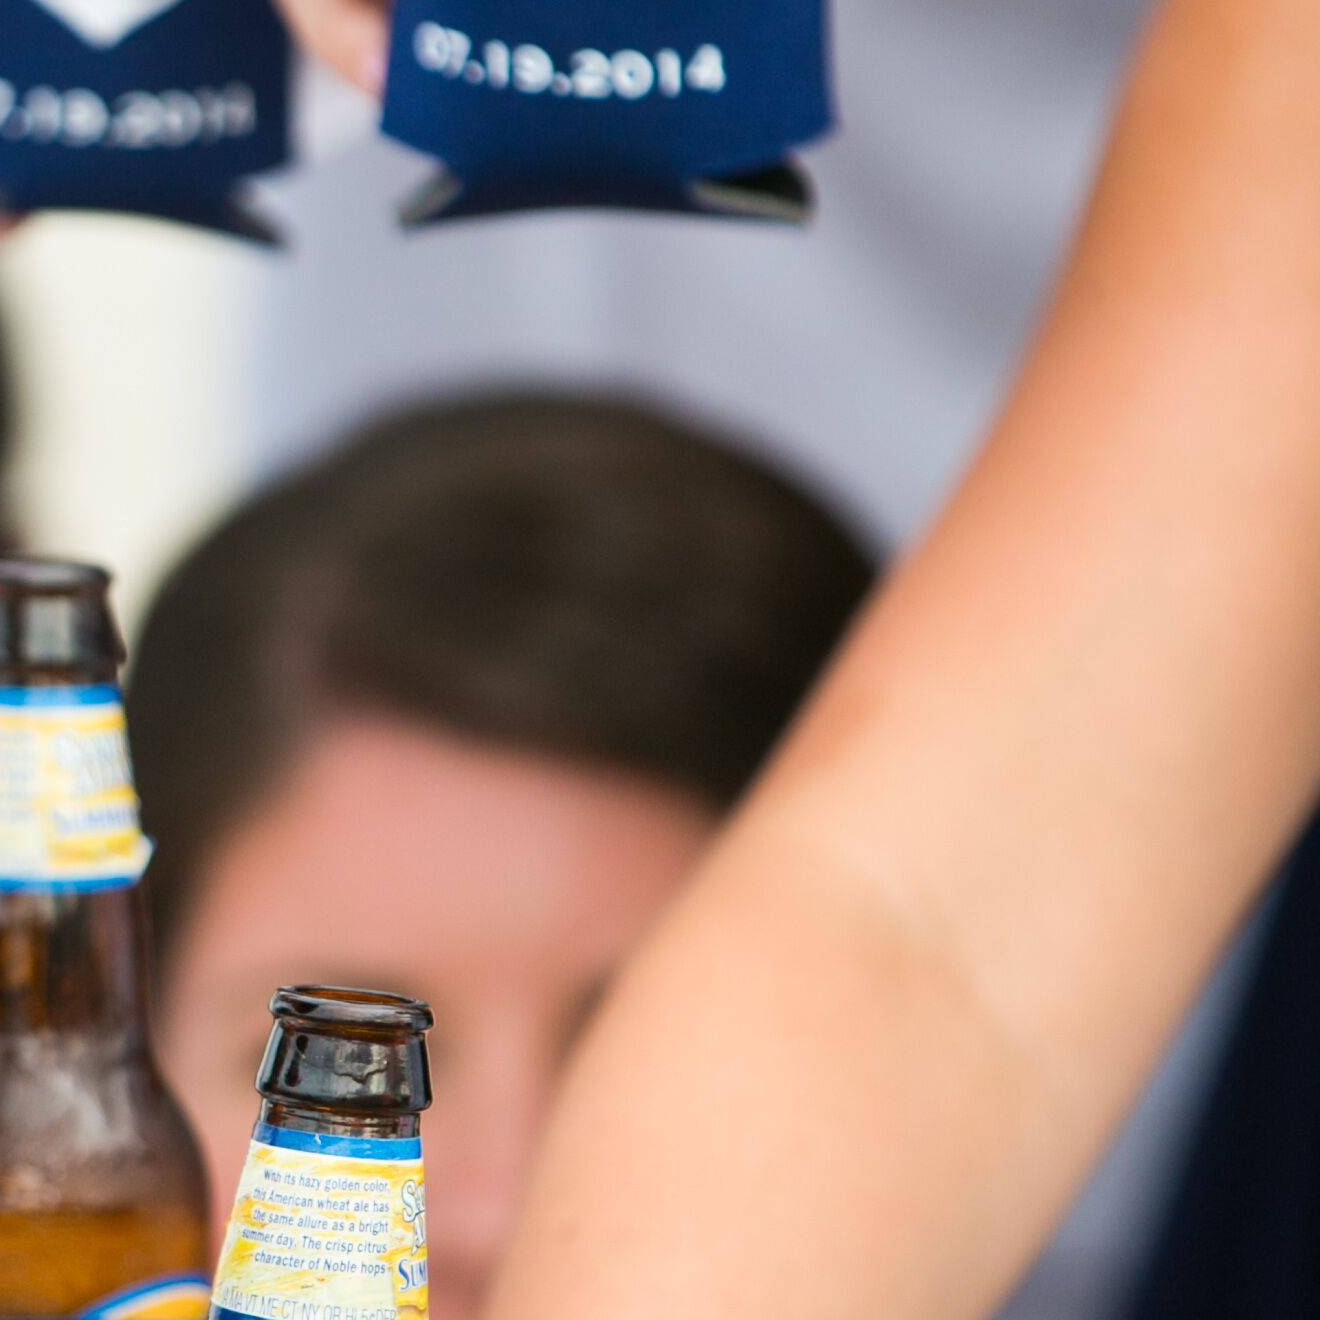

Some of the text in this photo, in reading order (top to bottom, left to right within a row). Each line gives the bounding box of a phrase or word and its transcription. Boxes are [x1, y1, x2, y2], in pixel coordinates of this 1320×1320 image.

[264, 1167, 282, 1180] With
[284, 1170, 296, 1185] its
[299, 1171, 321, 1190] hazy
[324, 1178, 361, 1193] golden
[253, 1187, 390, 1212] this American wheat ale has
[253, 1208, 389, 1236] the same allure as a bright
[241, 1228, 388, 1255] summer day. The crisp citrus
[254, 1250, 386, 1277] character of Noble hops
[245, 1293, 258, 1313] VT
[261, 1295, 278, 1318] ME
[281, 1297, 297, 1320] CT
